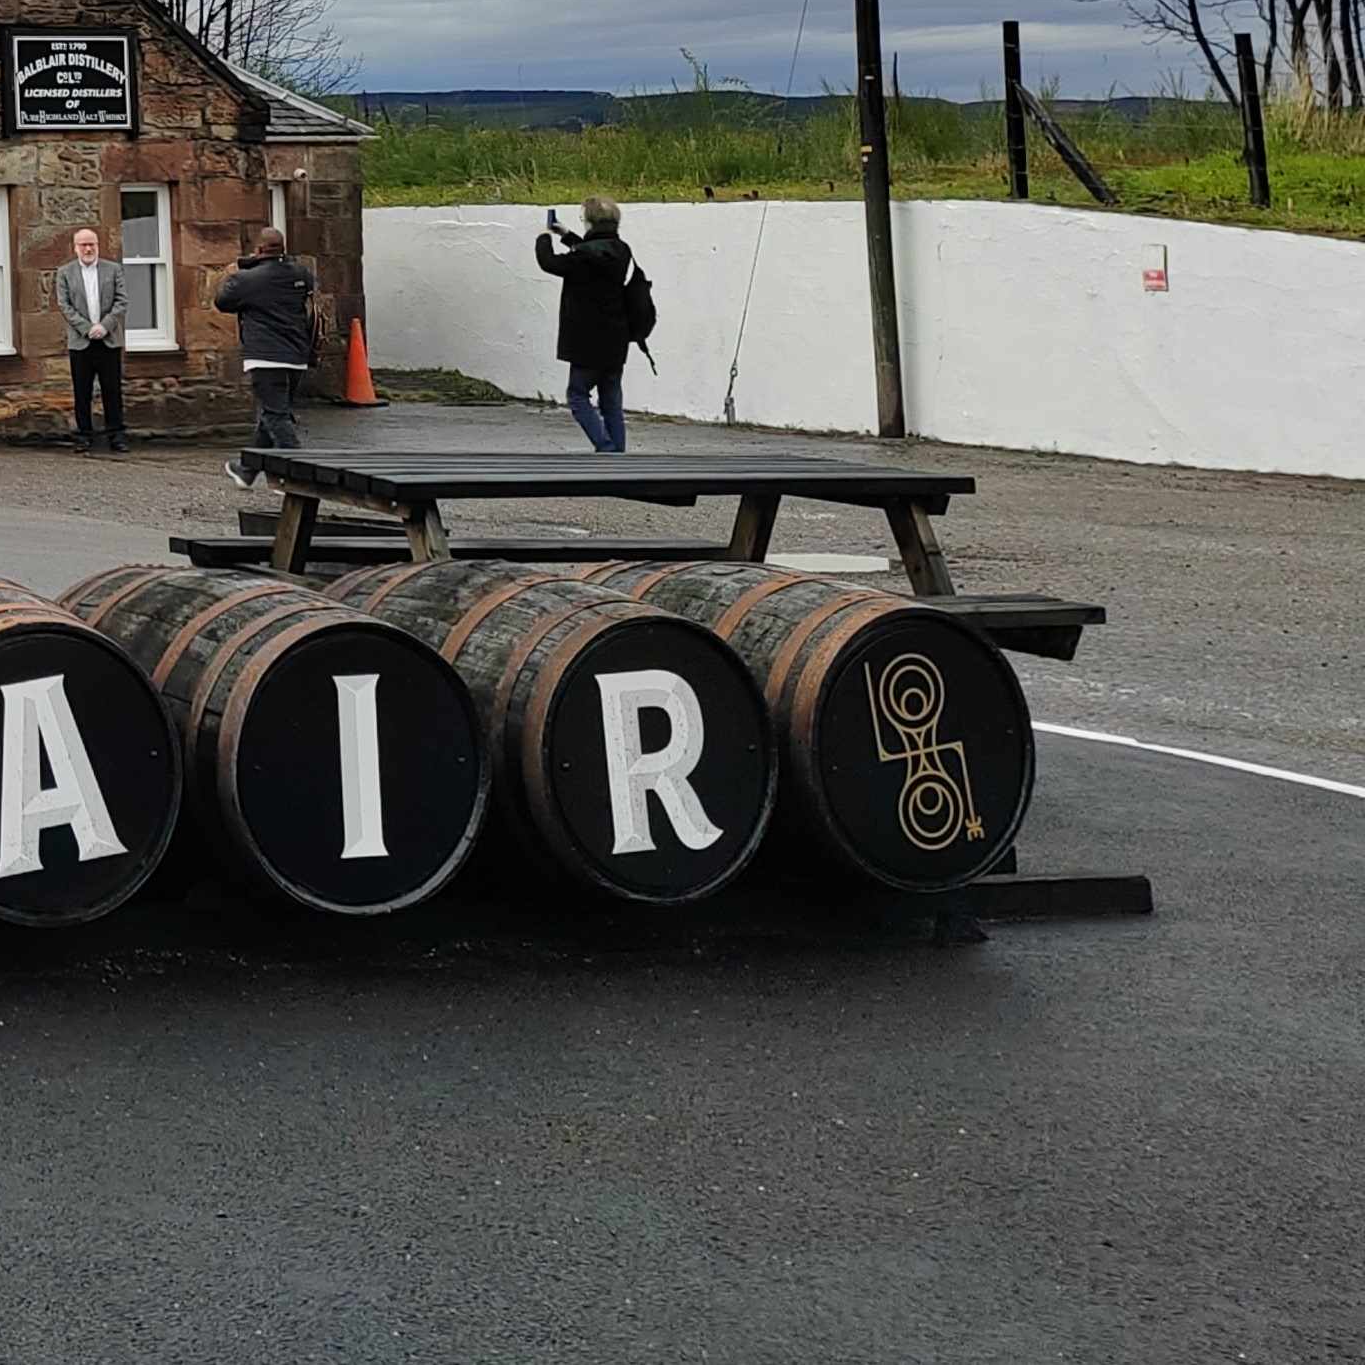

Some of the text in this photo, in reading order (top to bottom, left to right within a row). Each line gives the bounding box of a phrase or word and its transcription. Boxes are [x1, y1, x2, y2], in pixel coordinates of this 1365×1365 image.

[69, 42, 87, 51] 1790
[17, 53, 127, 85] BALBLAIR DISTILLERY
[24, 88, 123, 98] LICENSED DISTILLERS
[65, 99, 81, 109] OF
